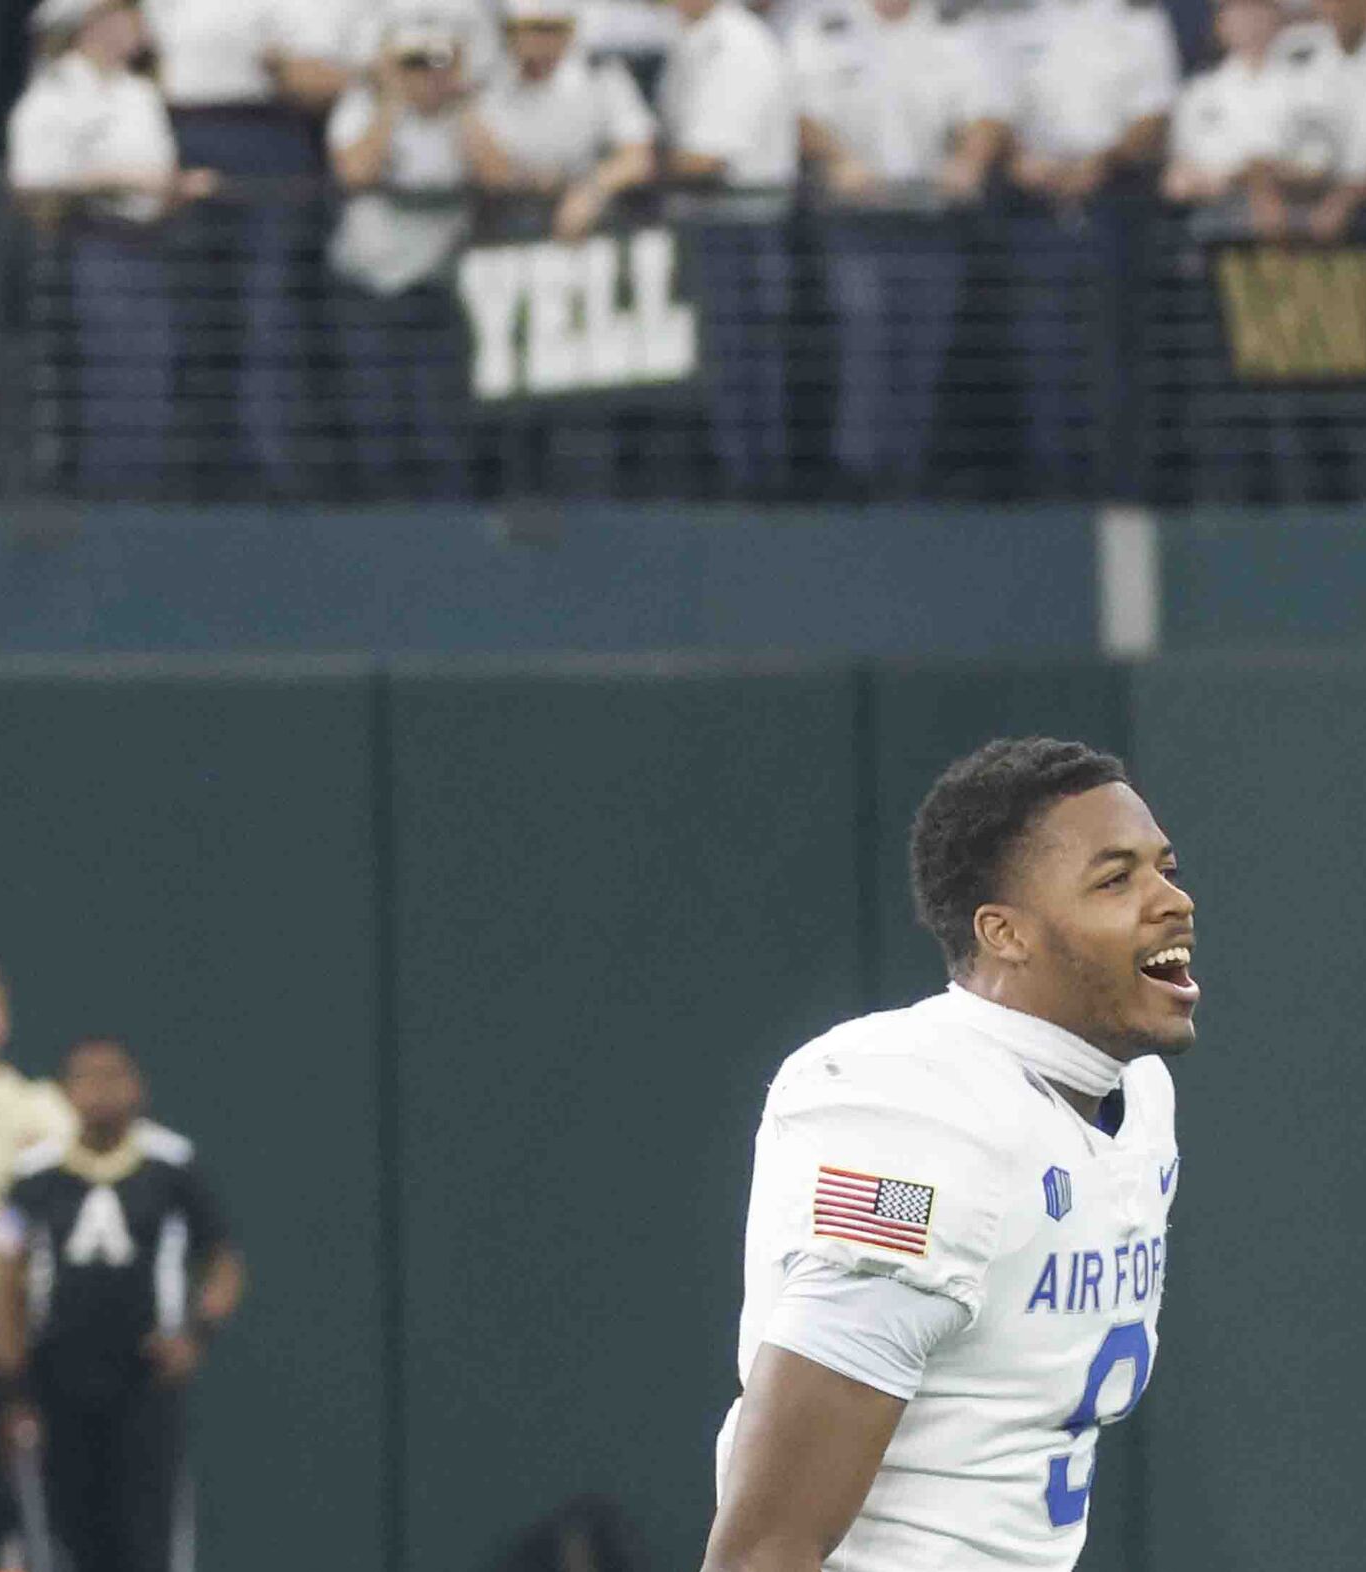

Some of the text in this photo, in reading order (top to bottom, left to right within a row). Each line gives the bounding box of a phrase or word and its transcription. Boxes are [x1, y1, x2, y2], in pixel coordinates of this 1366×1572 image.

[459, 229, 697, 400] YELL
[63, 1184, 134, 1268] A
[1026, 1236, 1163, 1313] AIR FOR
[1044, 1320, 1150, 1530] 9
